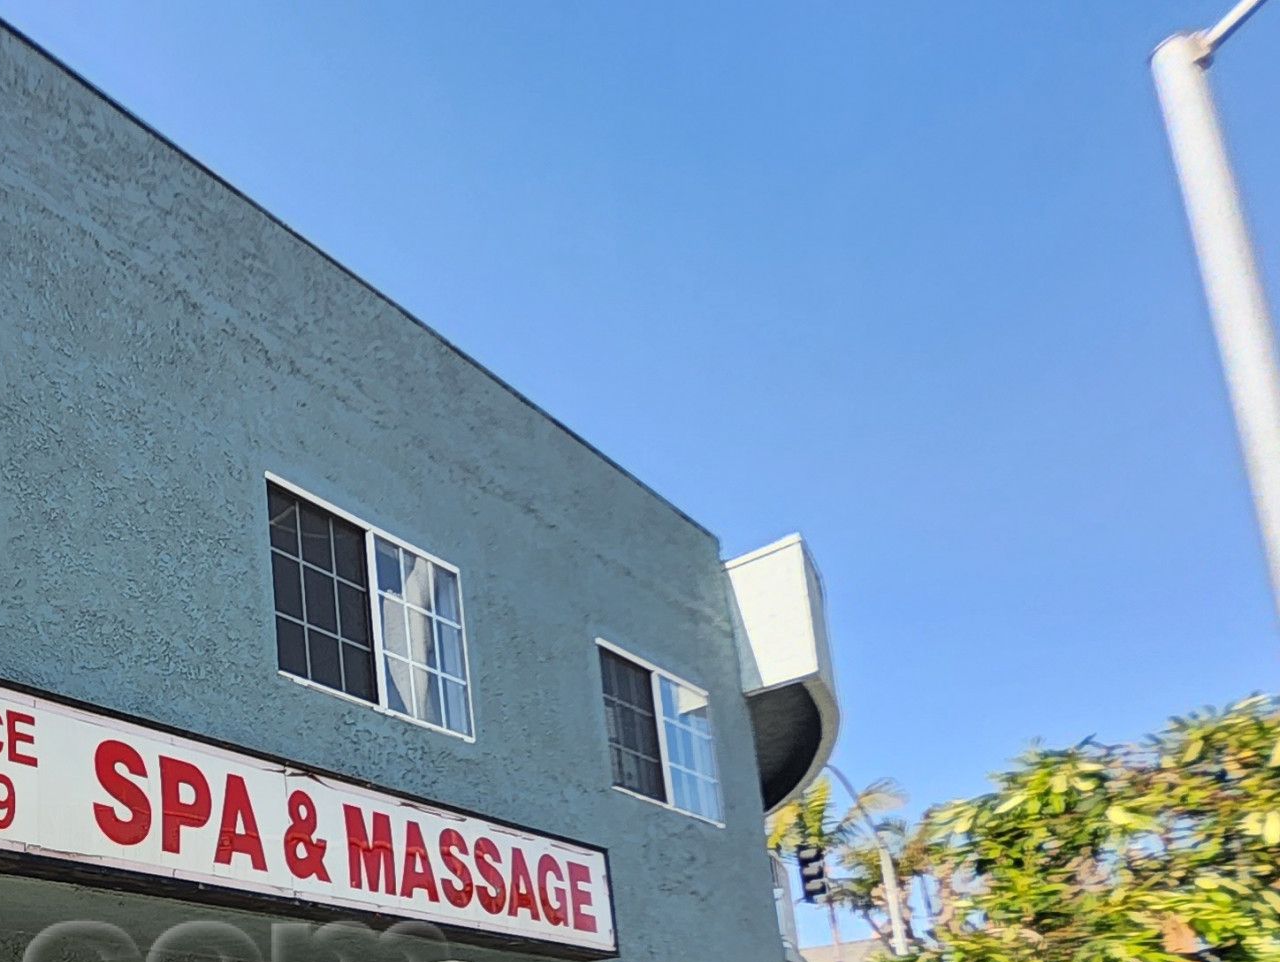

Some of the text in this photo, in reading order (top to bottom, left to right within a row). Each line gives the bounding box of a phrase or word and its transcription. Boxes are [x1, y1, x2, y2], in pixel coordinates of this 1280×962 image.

[92, 740, 599, 933] SPA & MASSAGE
